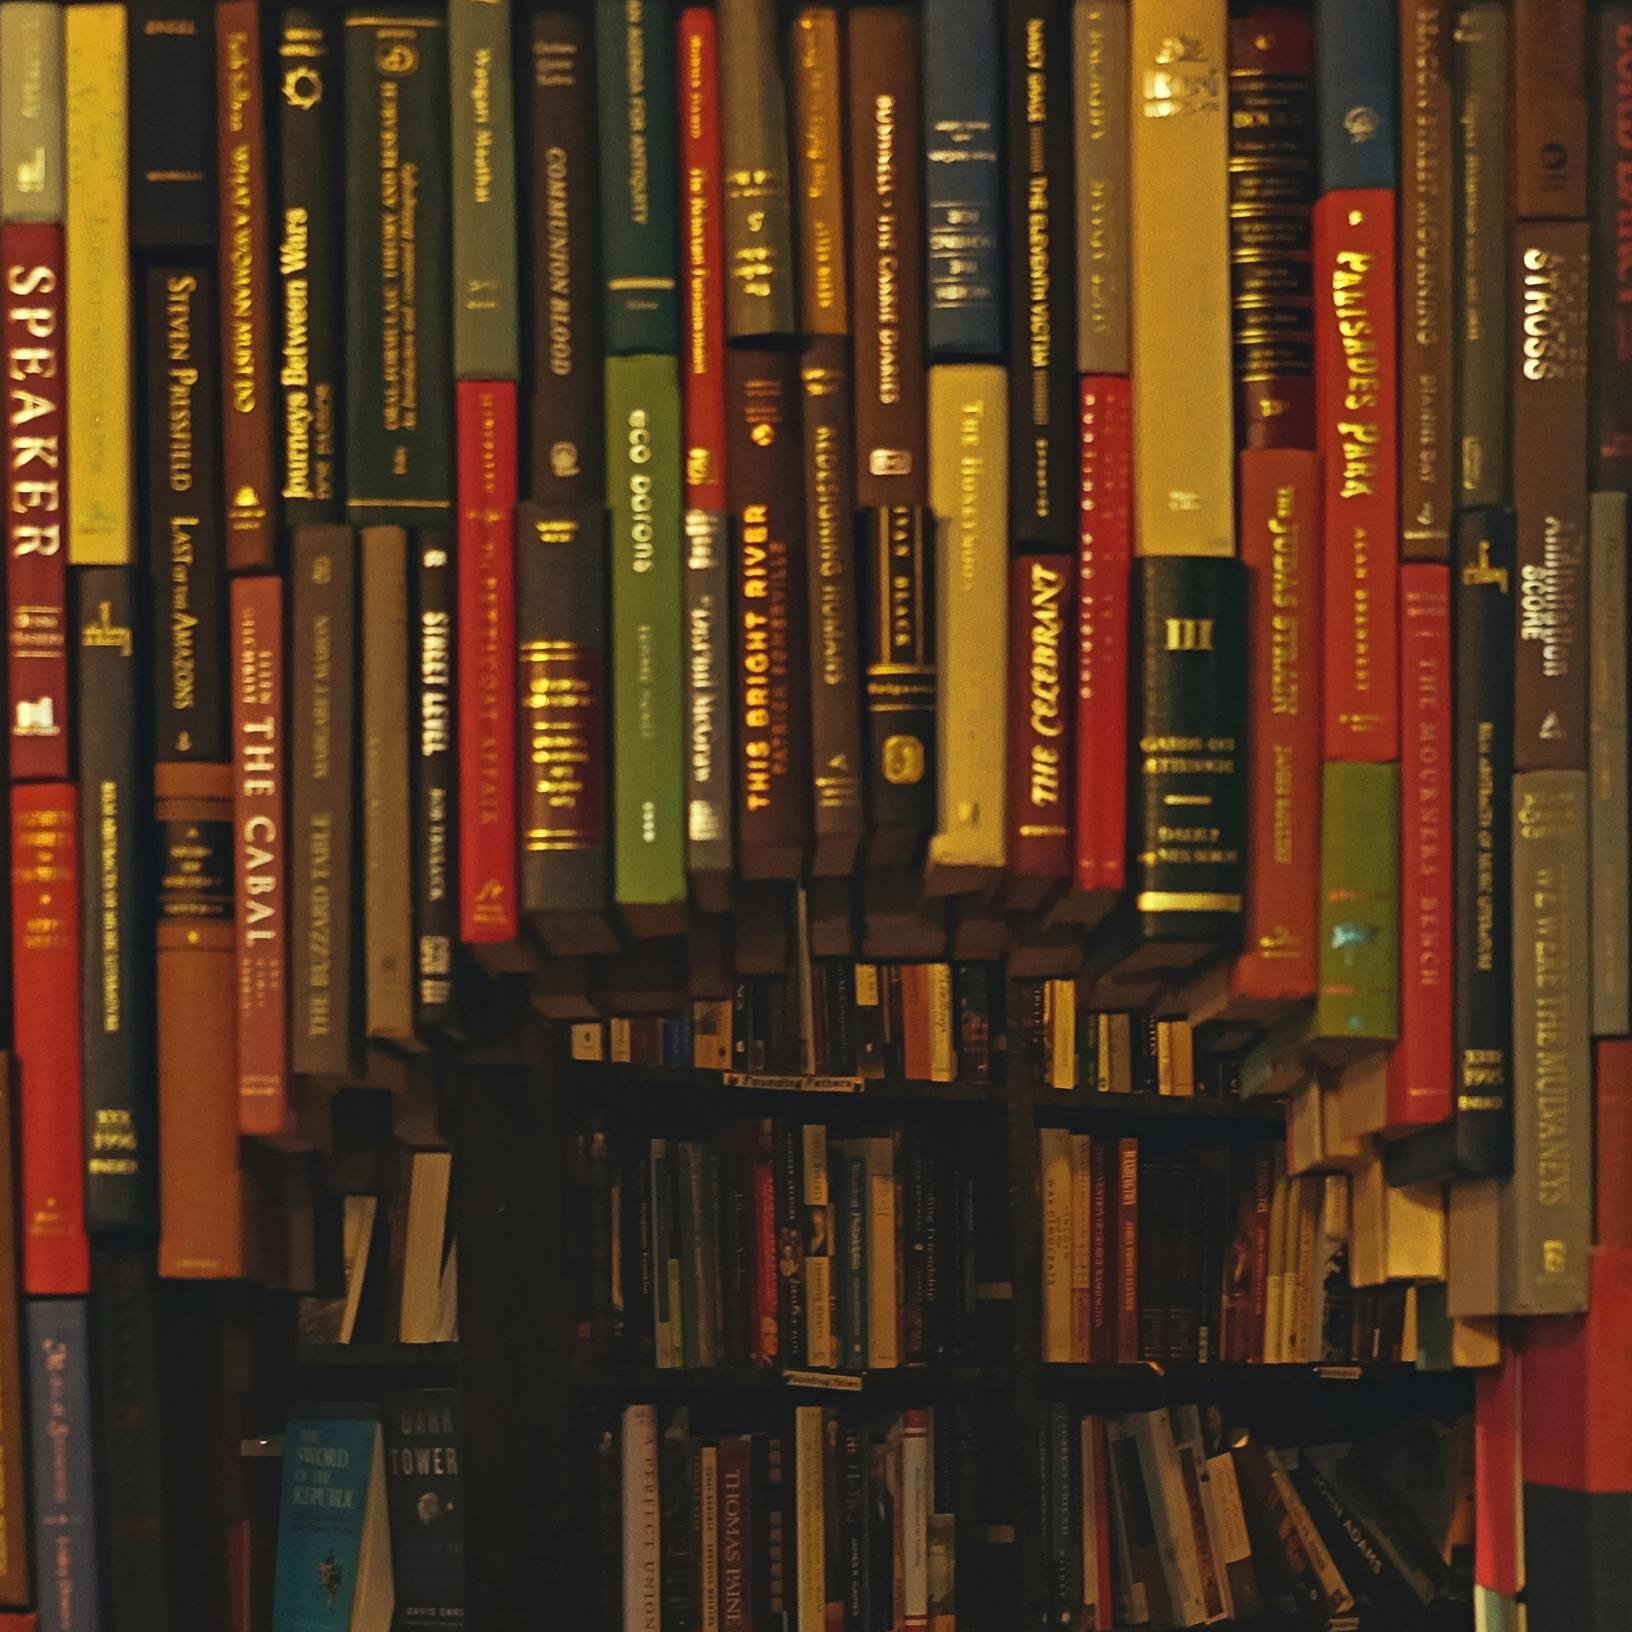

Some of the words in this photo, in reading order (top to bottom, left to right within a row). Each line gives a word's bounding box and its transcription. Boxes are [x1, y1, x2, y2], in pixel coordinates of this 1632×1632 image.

[280, 208, 308, 274] Wars
[545, 147, 570, 295] COMMUNION
[1028, 210, 1049, 302] ELEVENTH
[230, 228, 253, 318] WOMAN
[165, 275, 195, 362] STEVEN
[234, 323, 255, 372] MUST
[281, 279, 310, 387] Between
[551, 300, 572, 375] BLOOD
[1030, 303, 1051, 368] VICTIM
[1333, 251, 1377, 410] PALISADES
[1523, 248, 1552, 381] STROSS
[8, 264, 61, 557] SPEAKER
[168, 365, 199, 493] PRESSFIELD
[237, 377, 255, 412] DO
[282, 393, 312, 499] Journeys
[1338, 422, 1379, 498] PARK
[742, 504, 768, 598] RIVER
[1271, 520, 1297, 610] JUDAS
[1167, 618, 1215, 651] III
[1522, 565, 1547, 641] SCORE
[421, 611, 449, 685] STREET
[745, 612, 769, 726] BRIGHT
[1031, 563, 1068, 737] CELEBRANT
[1272, 616, 1297, 714] STRAIN
[242, 718, 276, 797] THE
[422, 692, 449, 756] LEVEL
[746, 740, 770, 811] THIS
[1031, 746, 1060, 807] THE
[243, 815, 277, 940] CABAL
[744, 1074, 802, 1090] Founding
[807, 1076, 852, 1090] Fathers
[296, 1445, 348, 1469] SWORD
[391, 1448, 459, 1476] TOWER
[723, 1467, 745, 1553] THOMAS
[1343, 1520, 1383, 1575] ADAMS
[725, 1561, 743, 1627] PAINE
